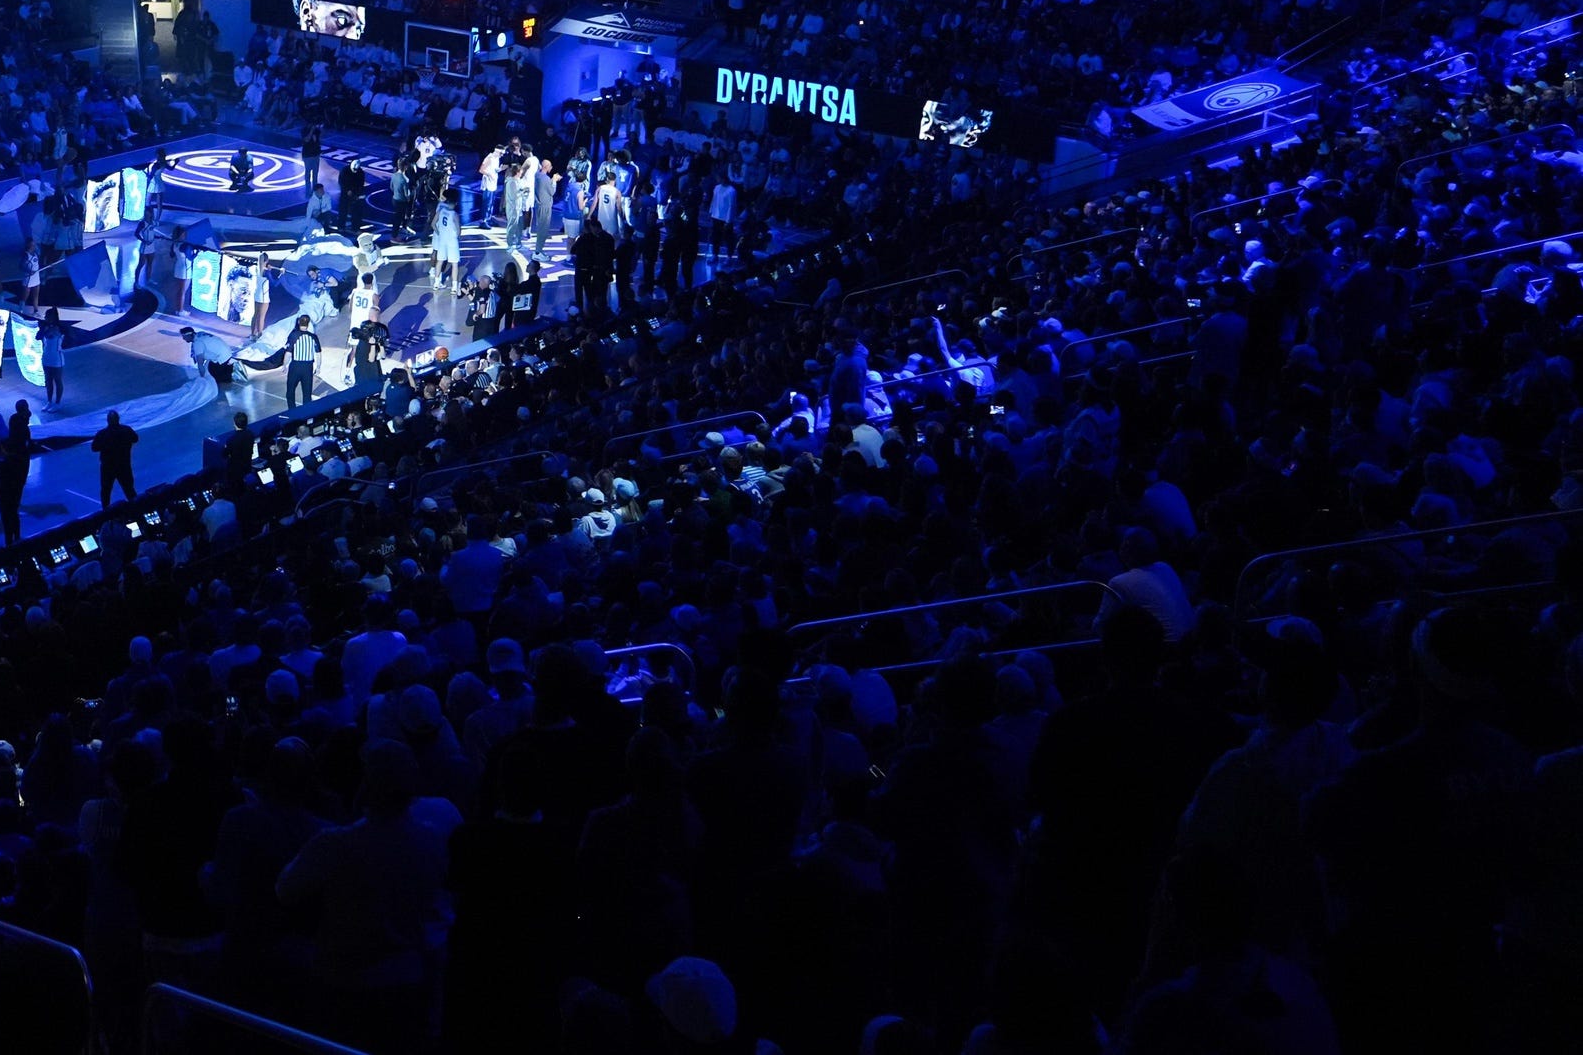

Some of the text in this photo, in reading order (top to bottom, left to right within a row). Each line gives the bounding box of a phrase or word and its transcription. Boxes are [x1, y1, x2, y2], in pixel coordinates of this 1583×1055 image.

[603, 194, 610, 204] 5
[442, 217, 449, 226] 6
[197, 259, 216, 301] 3
[355, 297, 368, 309] 30
[17, 327, 41, 372] 3
